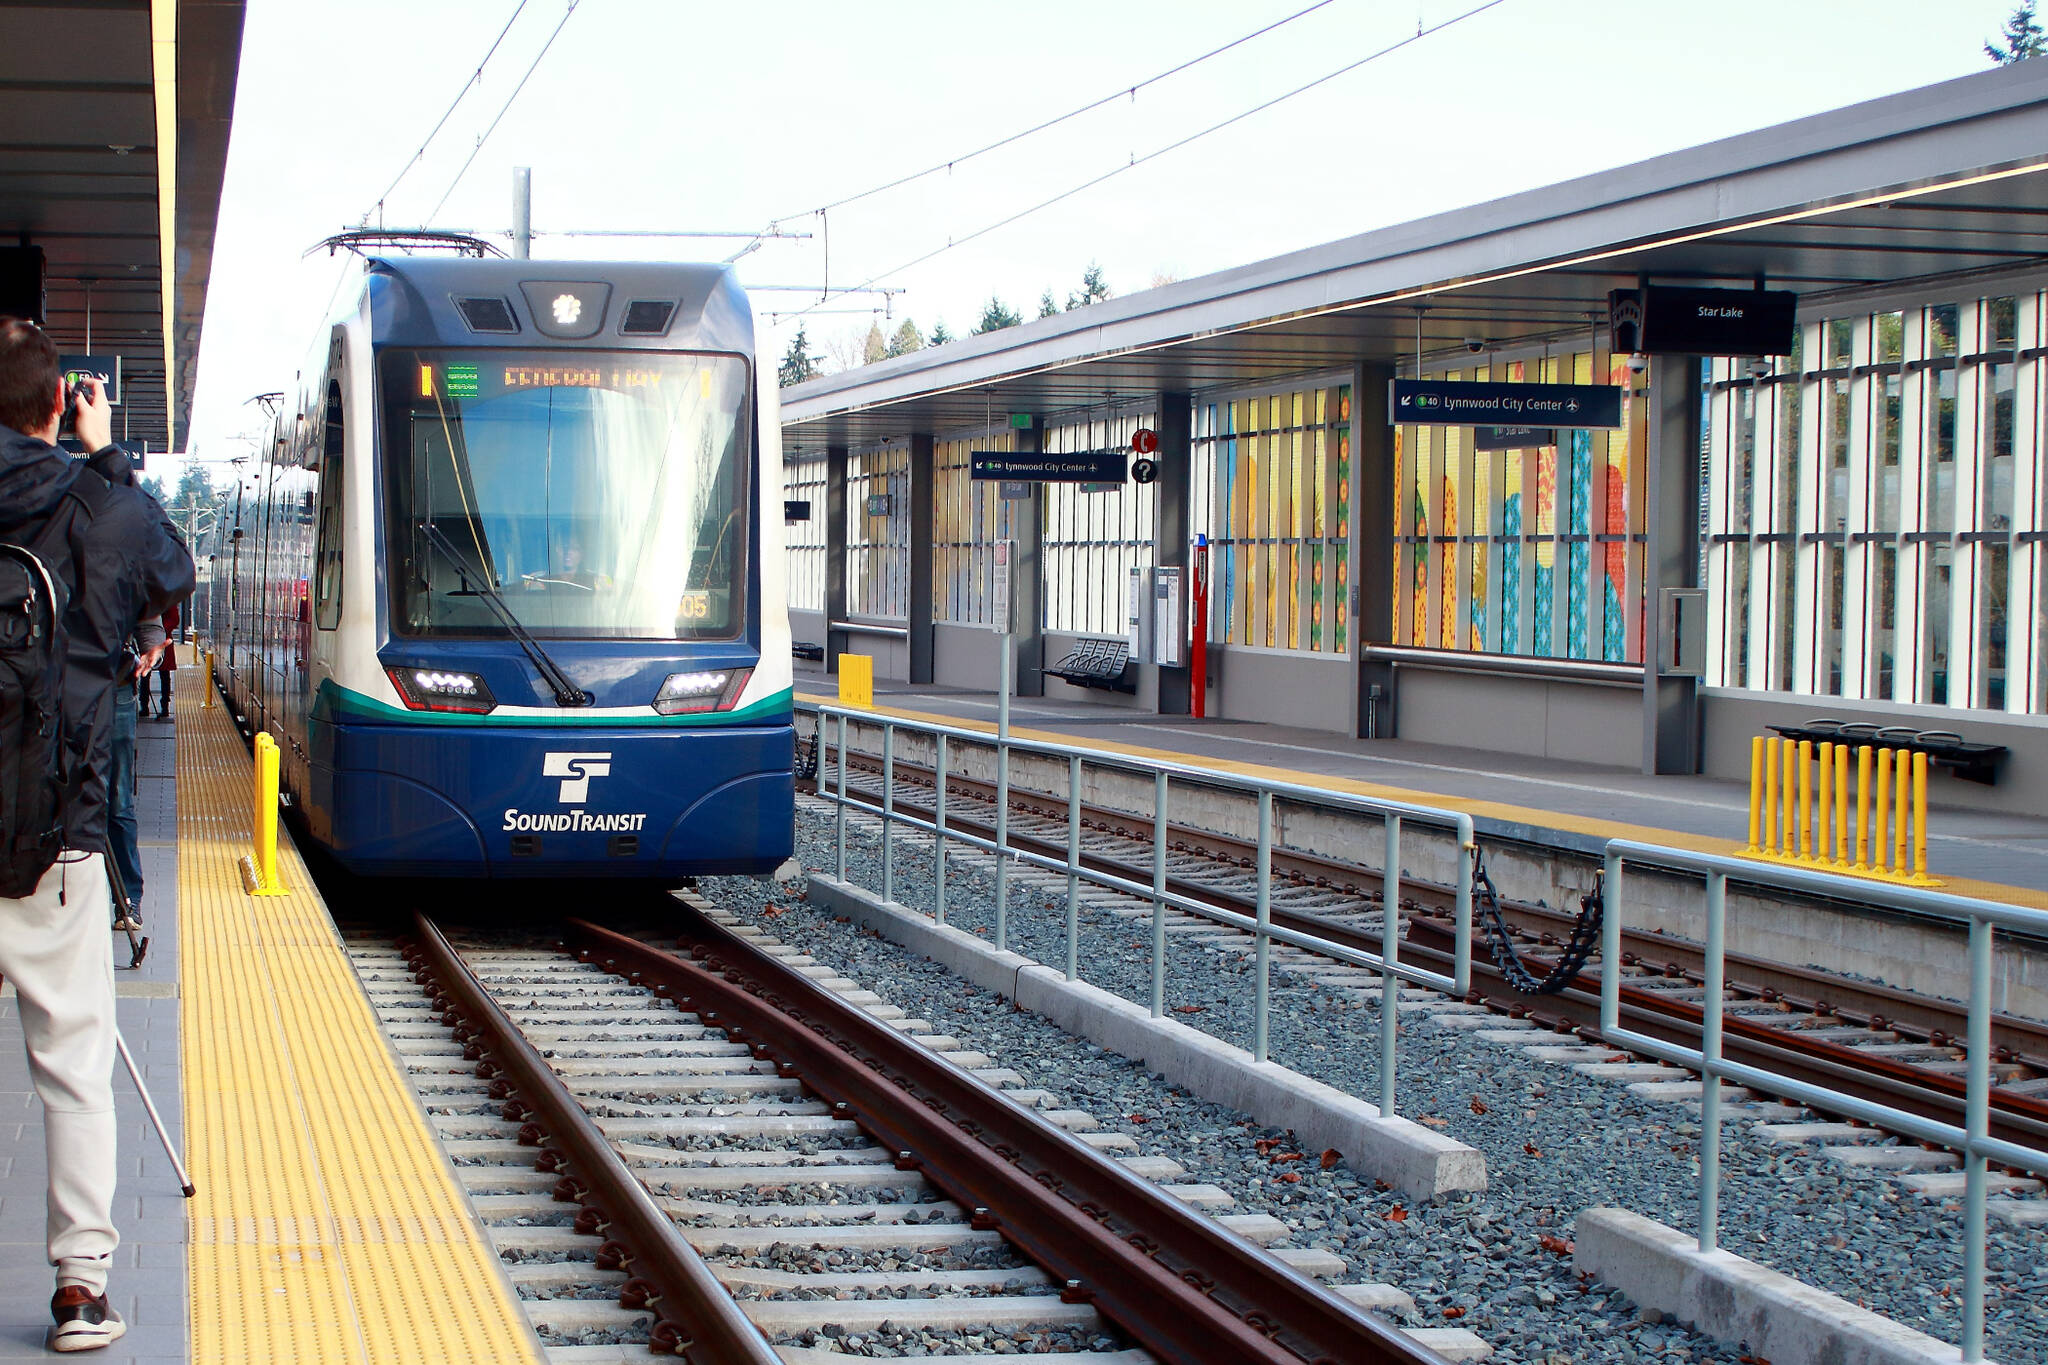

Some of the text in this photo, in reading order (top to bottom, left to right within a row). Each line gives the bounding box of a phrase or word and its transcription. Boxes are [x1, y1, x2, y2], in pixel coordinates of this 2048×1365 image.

[1698, 306, 1744, 318] Star Lake
[1427, 396, 1438, 406] 40
[1444, 396, 1499, 410] Lynnwood
[1502, 397, 1523, 412] City
[1526, 398, 1563, 411] Center
[1005, 461, 1043, 472] Lynnwood
[1044, 462, 1059, 473] City
[1061, 462, 1086, 472] Center
